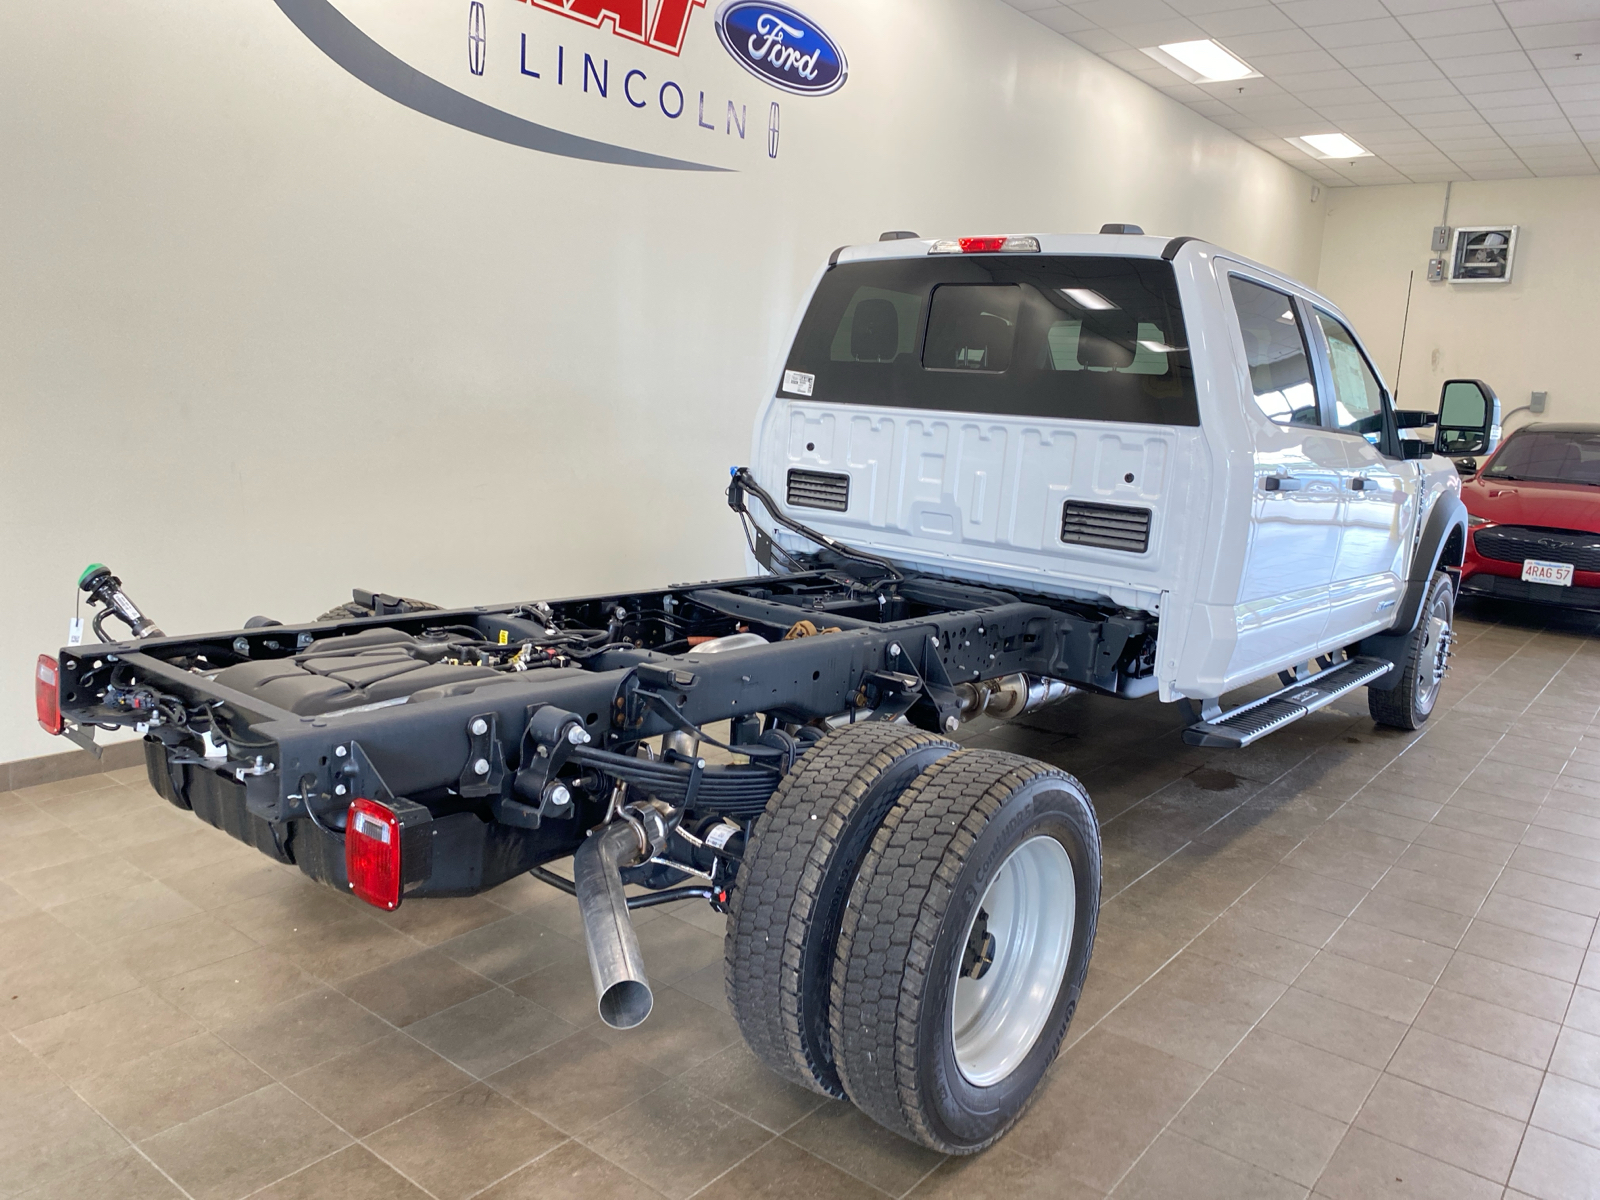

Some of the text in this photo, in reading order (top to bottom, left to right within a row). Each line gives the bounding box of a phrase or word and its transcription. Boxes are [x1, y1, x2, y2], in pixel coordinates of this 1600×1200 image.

[748, 13, 821, 80] Ford
[520, 33, 746, 139] LINCOLN
[1525, 565, 1570, 580] 4RAG 57
